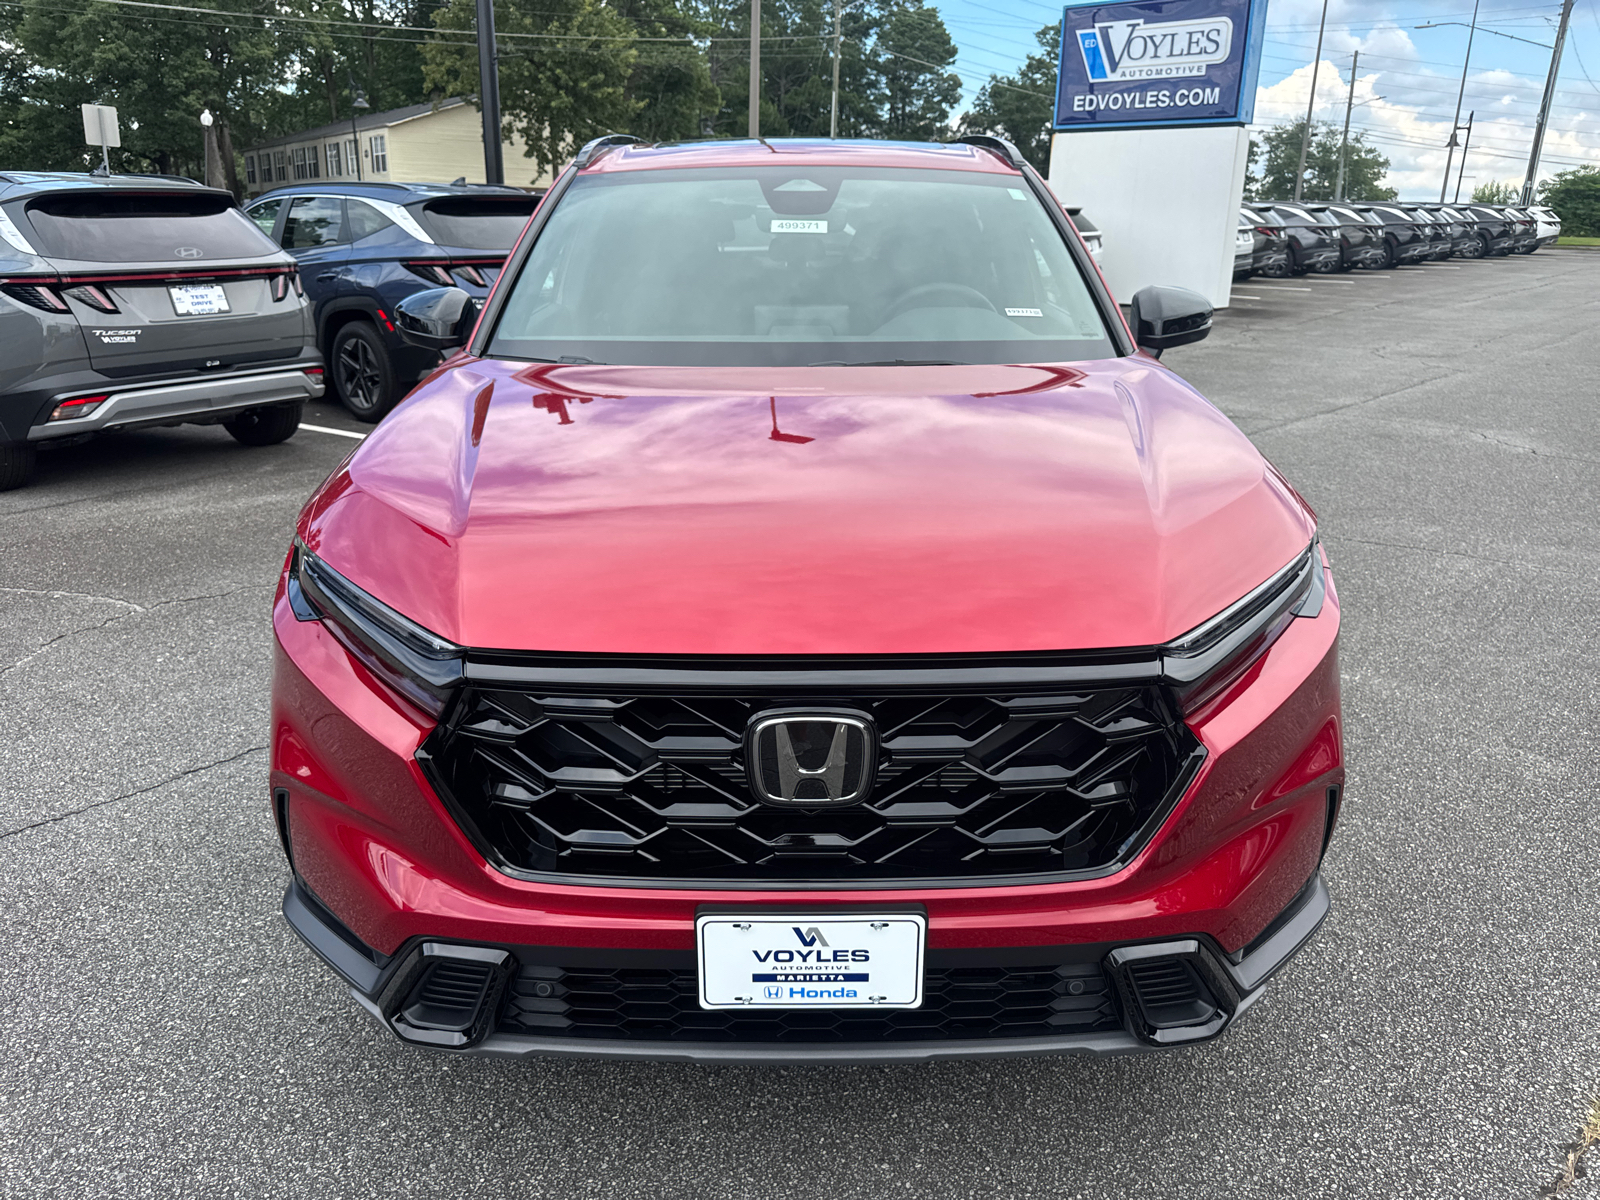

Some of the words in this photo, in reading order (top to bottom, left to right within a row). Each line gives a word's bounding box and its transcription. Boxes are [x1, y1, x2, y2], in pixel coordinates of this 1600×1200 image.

[1084, 39, 1097, 49] ED
[1097, 22, 1221, 74] VOYLES
[1120, 64, 1204, 78] AUTOMOTIVE
[1072, 87, 1221, 112] EDVOYLES.COM
[777, 221, 819, 230] 499371
[752, 949, 870, 963] VOYLES
[776, 974, 845, 982] MARIETTA
[789, 986, 858, 999] Honda
